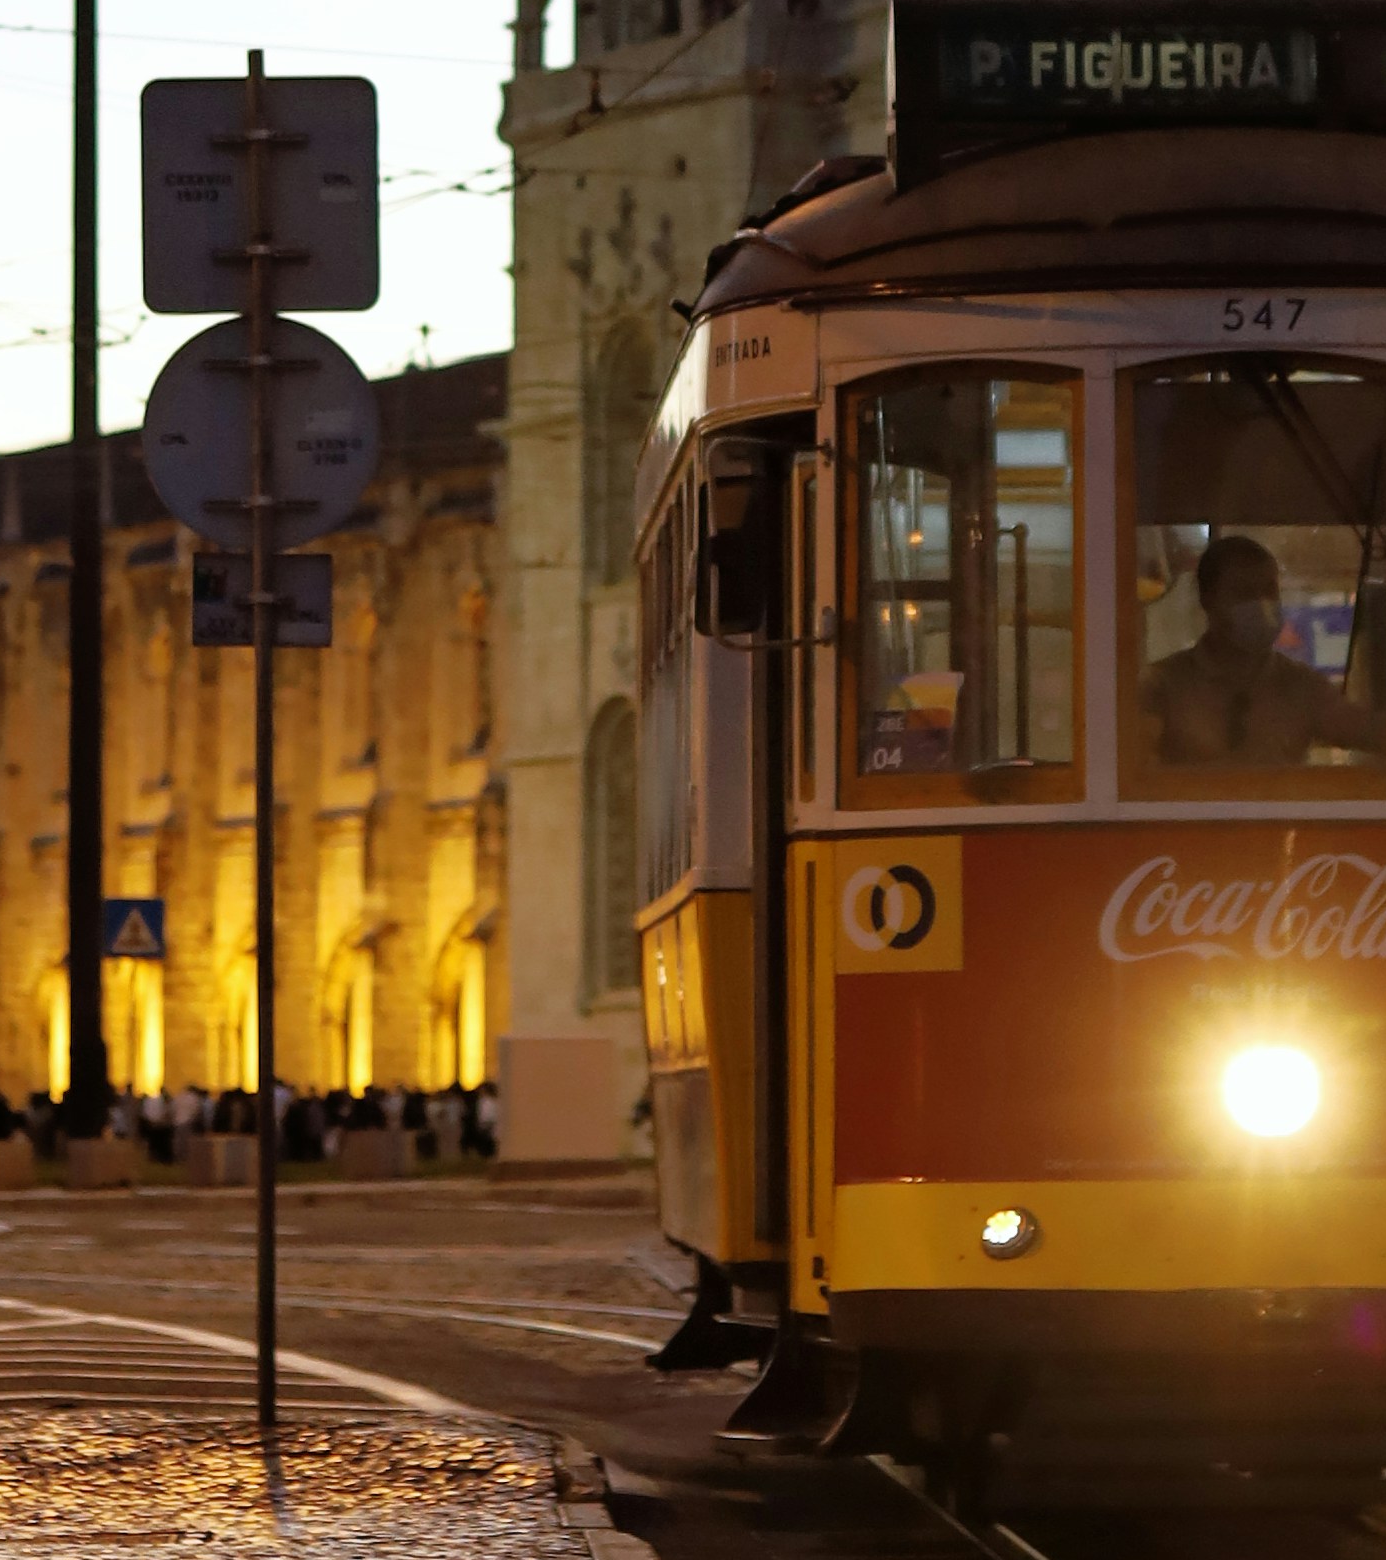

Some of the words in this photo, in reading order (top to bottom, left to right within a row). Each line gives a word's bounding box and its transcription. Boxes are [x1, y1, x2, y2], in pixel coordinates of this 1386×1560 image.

[1030, 40, 1281, 89] FIGUEIRA
[1222, 299, 1307, 331] 547
[715, 336, 772, 368] ENTRADA
[873, 746, 903, 771] 04
